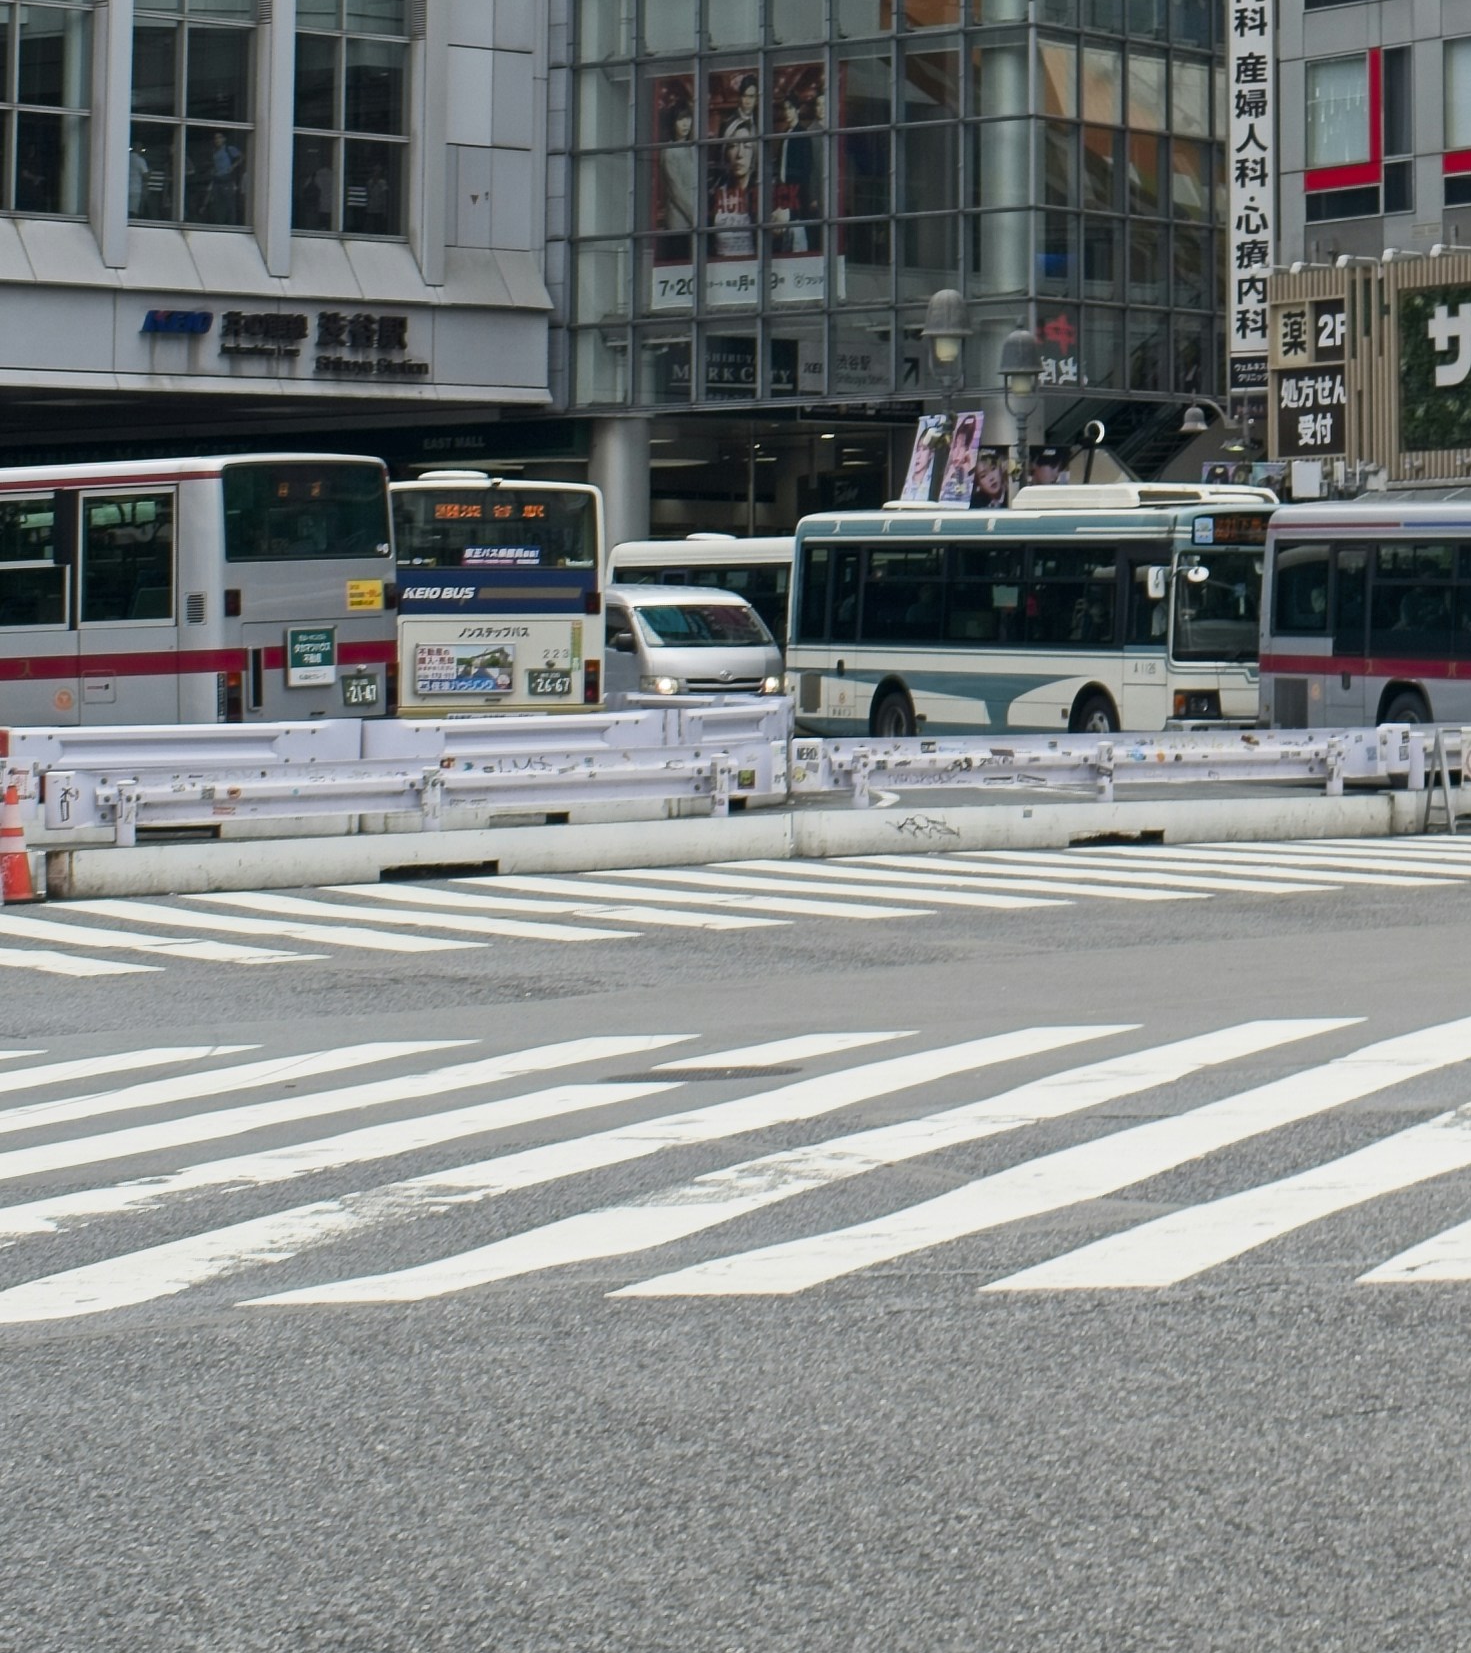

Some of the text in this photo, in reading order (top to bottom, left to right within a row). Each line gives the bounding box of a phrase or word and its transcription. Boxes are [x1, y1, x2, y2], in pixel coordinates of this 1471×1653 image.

[1281, 310, 1307, 358] 薬
[1317, 313, 1346, 349] 2F
[1279, 375, 1347, 410] 処方せん
[1297, 411, 1334, 447] 受付
[403, 586, 476, 599] KEIO BUS
[458, 627, 531, 639] ノンステップバス
[543, 649, 569, 660] 223
